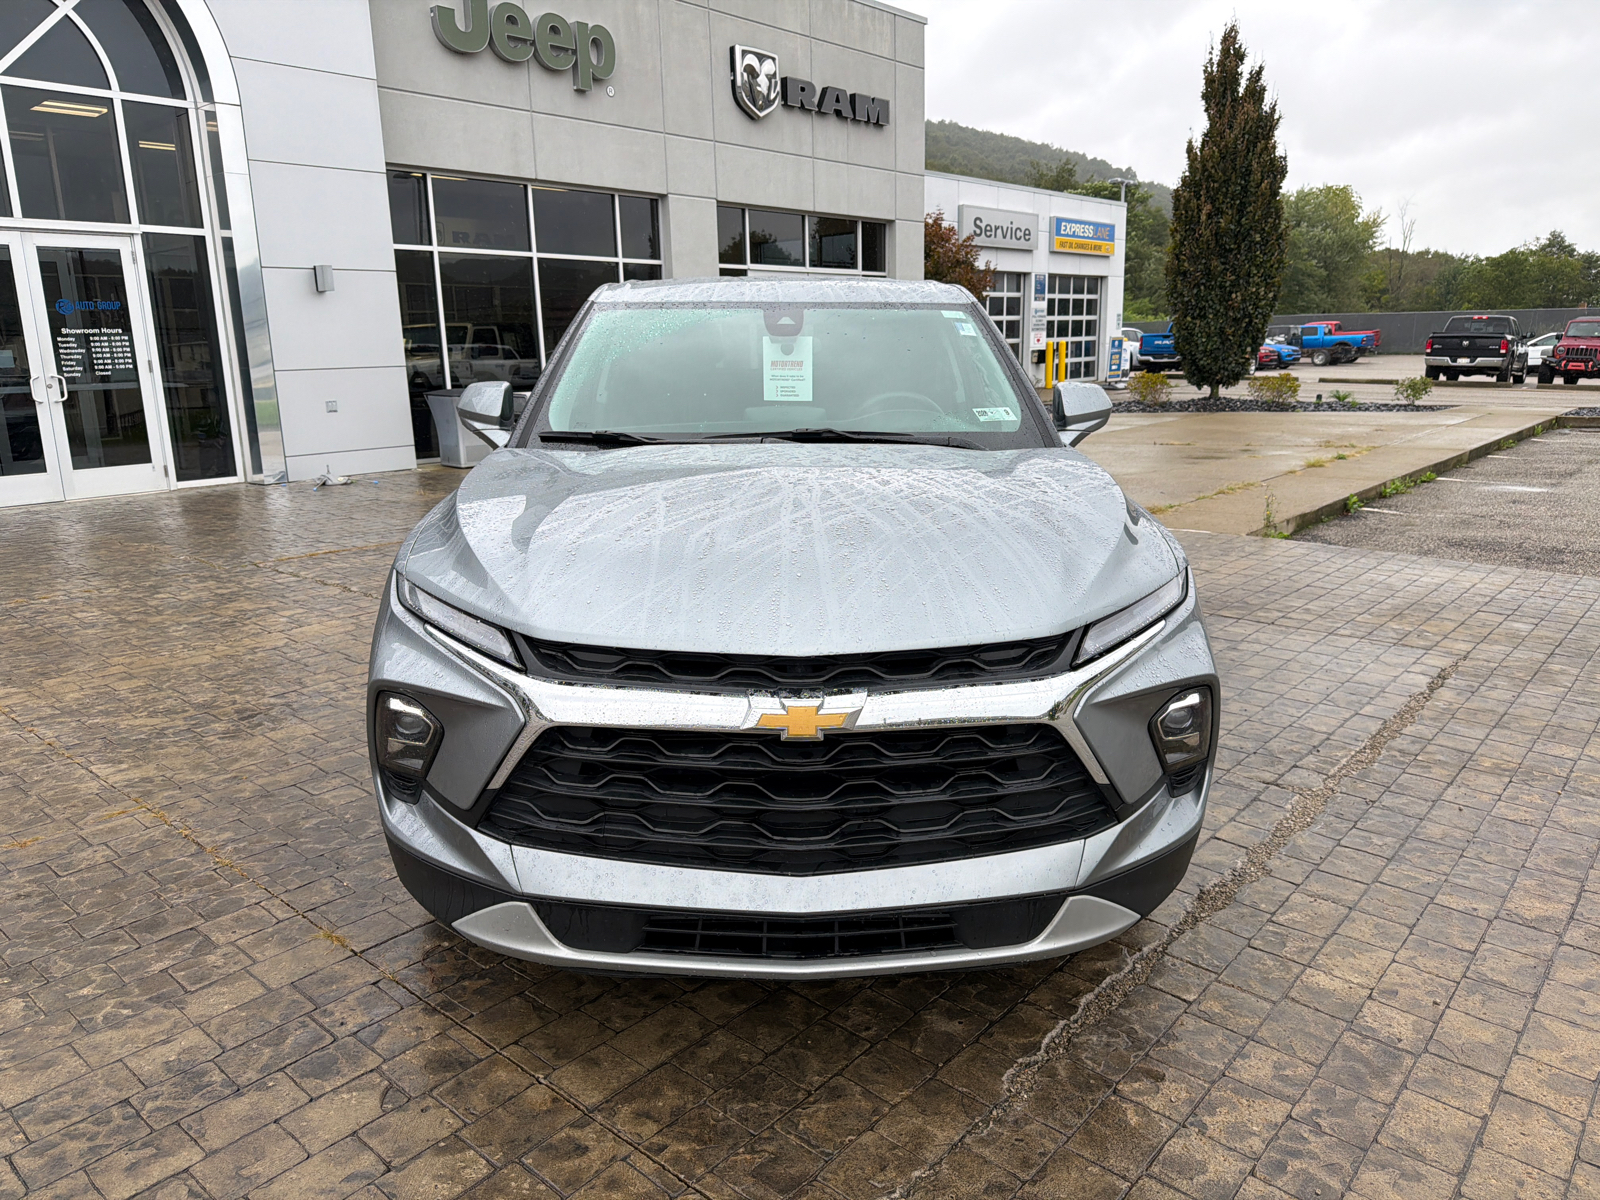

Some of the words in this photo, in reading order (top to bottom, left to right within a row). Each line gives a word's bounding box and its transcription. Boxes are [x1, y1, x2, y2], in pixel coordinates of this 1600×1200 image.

[430, 0, 616, 92] Jeep
[781, 76, 890, 126] RAM
[973, 216, 1031, 242] Service
[76, 301, 95, 310] AUTO
[97, 301, 121, 310] GROUP
